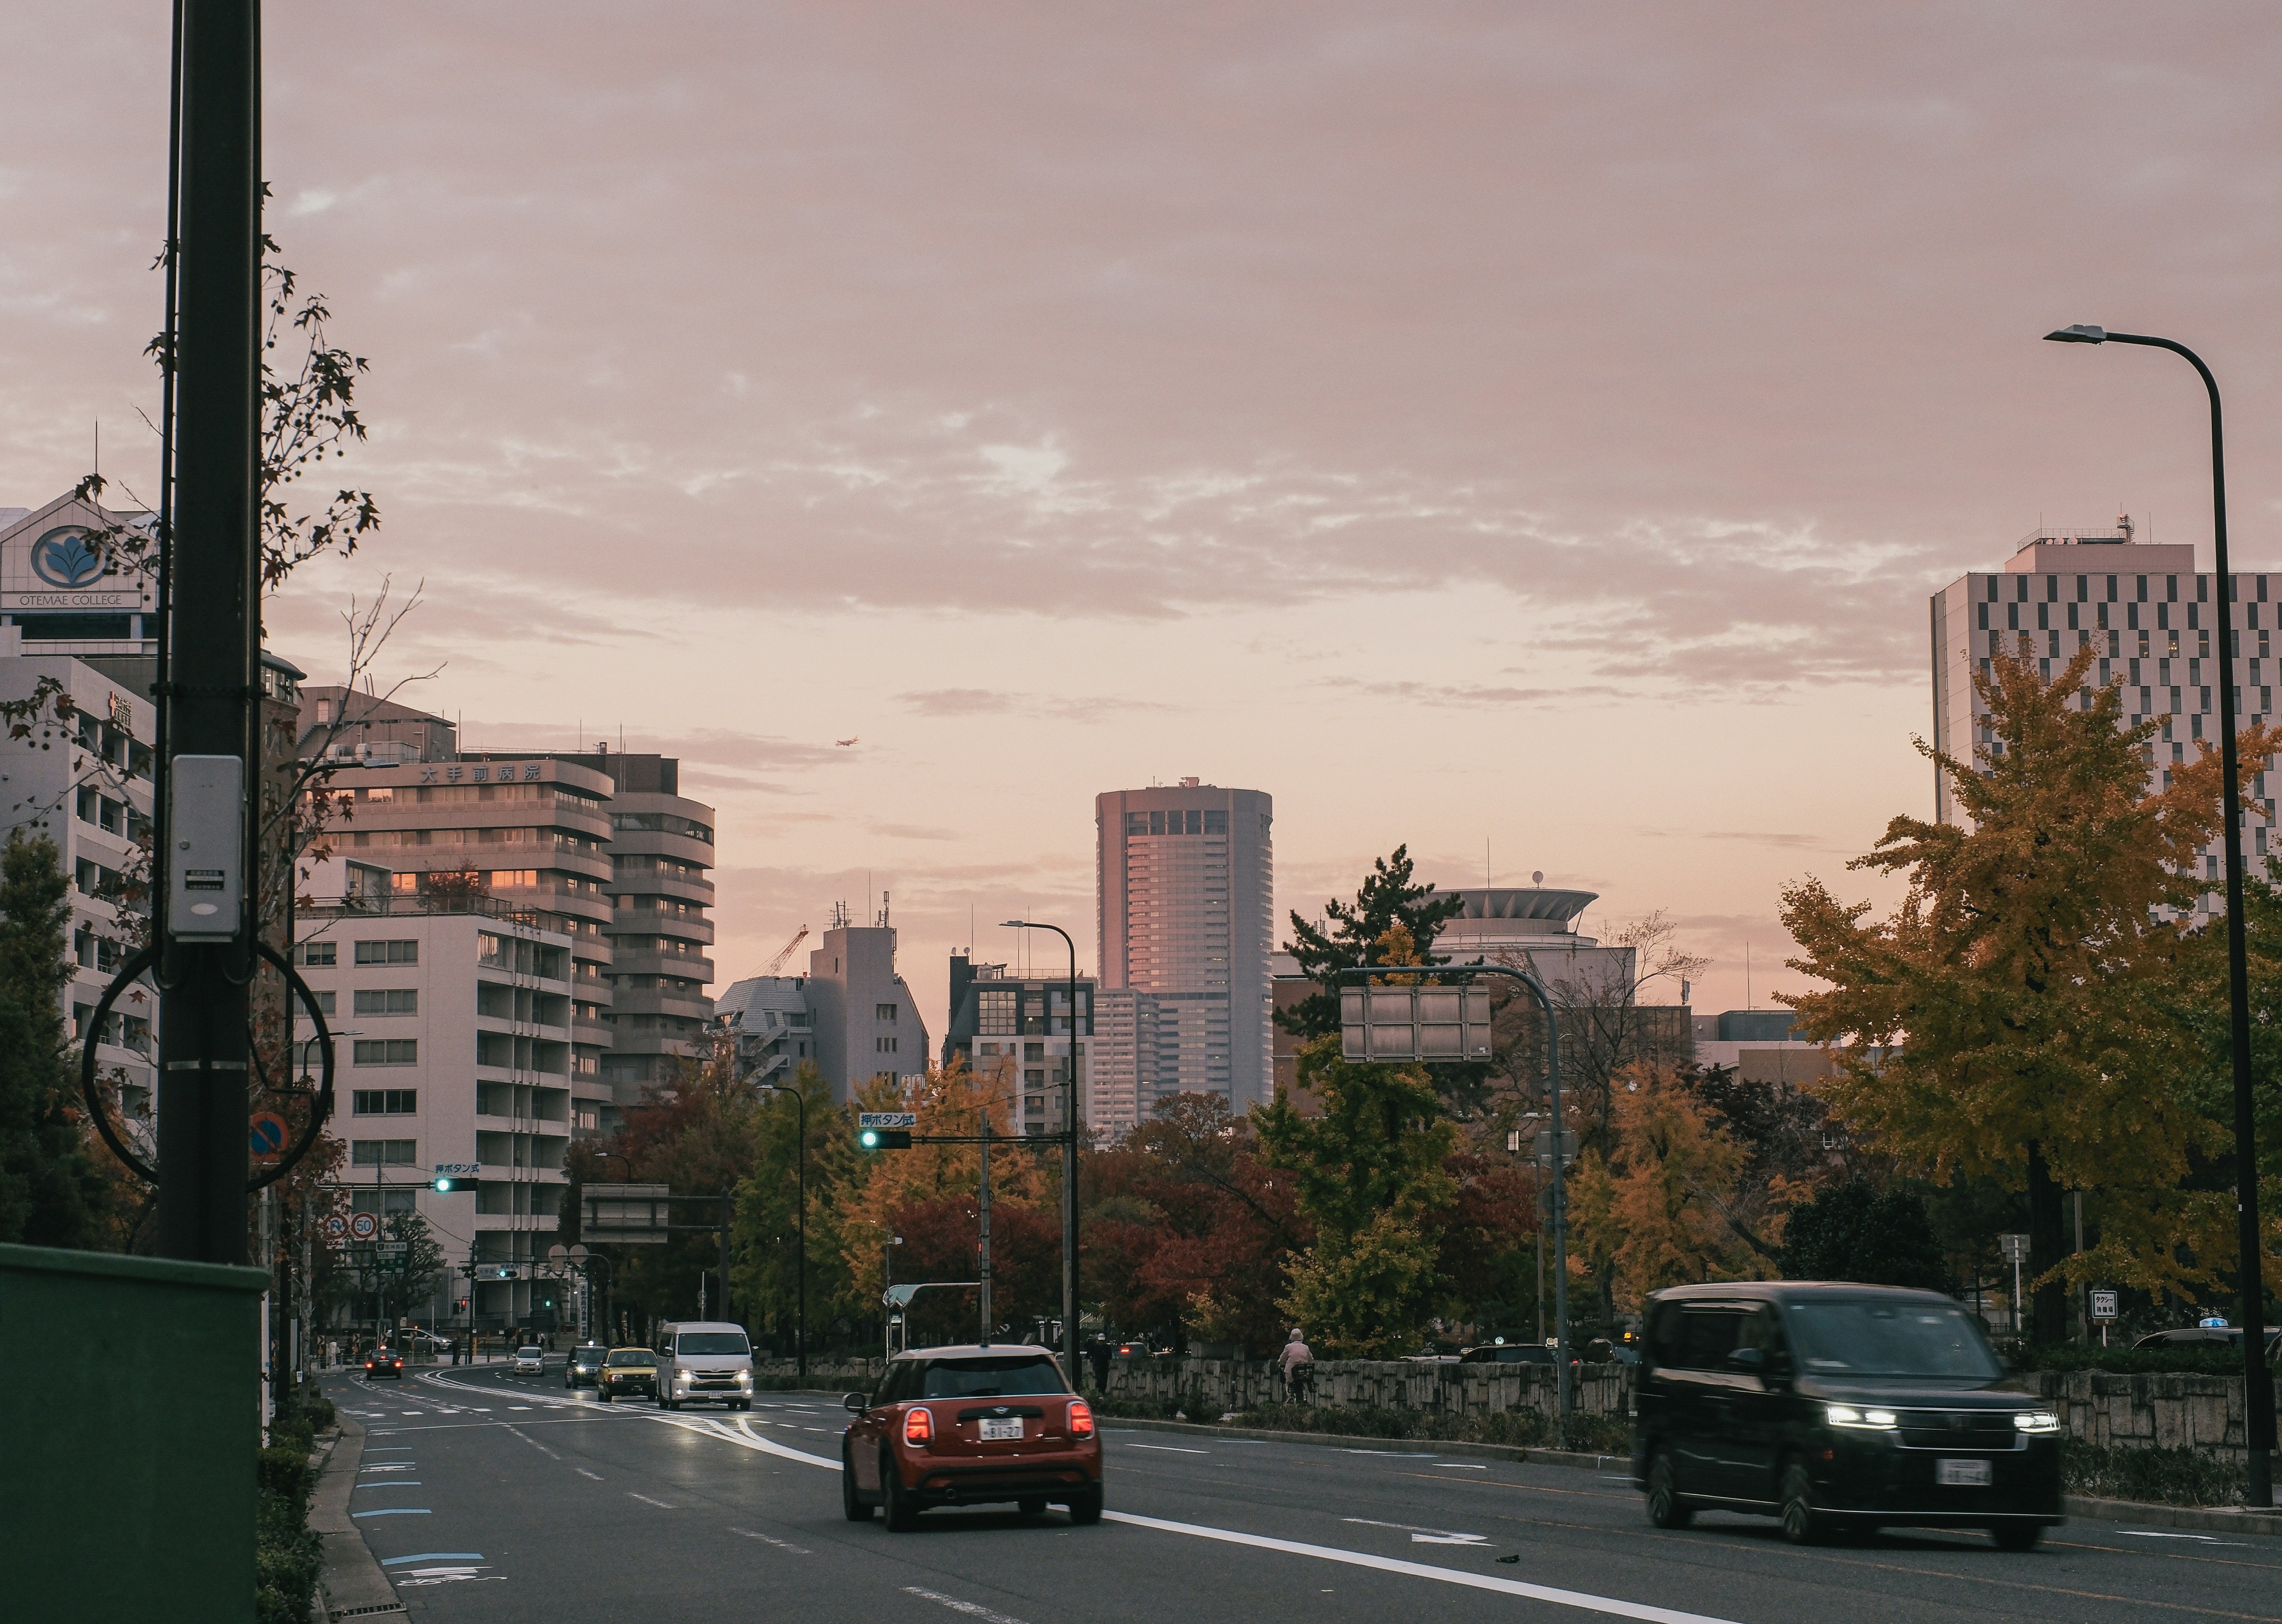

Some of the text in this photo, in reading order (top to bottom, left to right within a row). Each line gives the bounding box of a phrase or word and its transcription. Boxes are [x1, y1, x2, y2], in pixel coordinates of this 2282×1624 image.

[20, 595, 122, 605] OTEMAE COLLEGE
[421, 764, 540, 783] 大手前病院
[861, 1114, 914, 1125] 押ボタン式
[435, 1164, 479, 1173] 押ボタン式
[357, 1220, 371, 1231] 50
